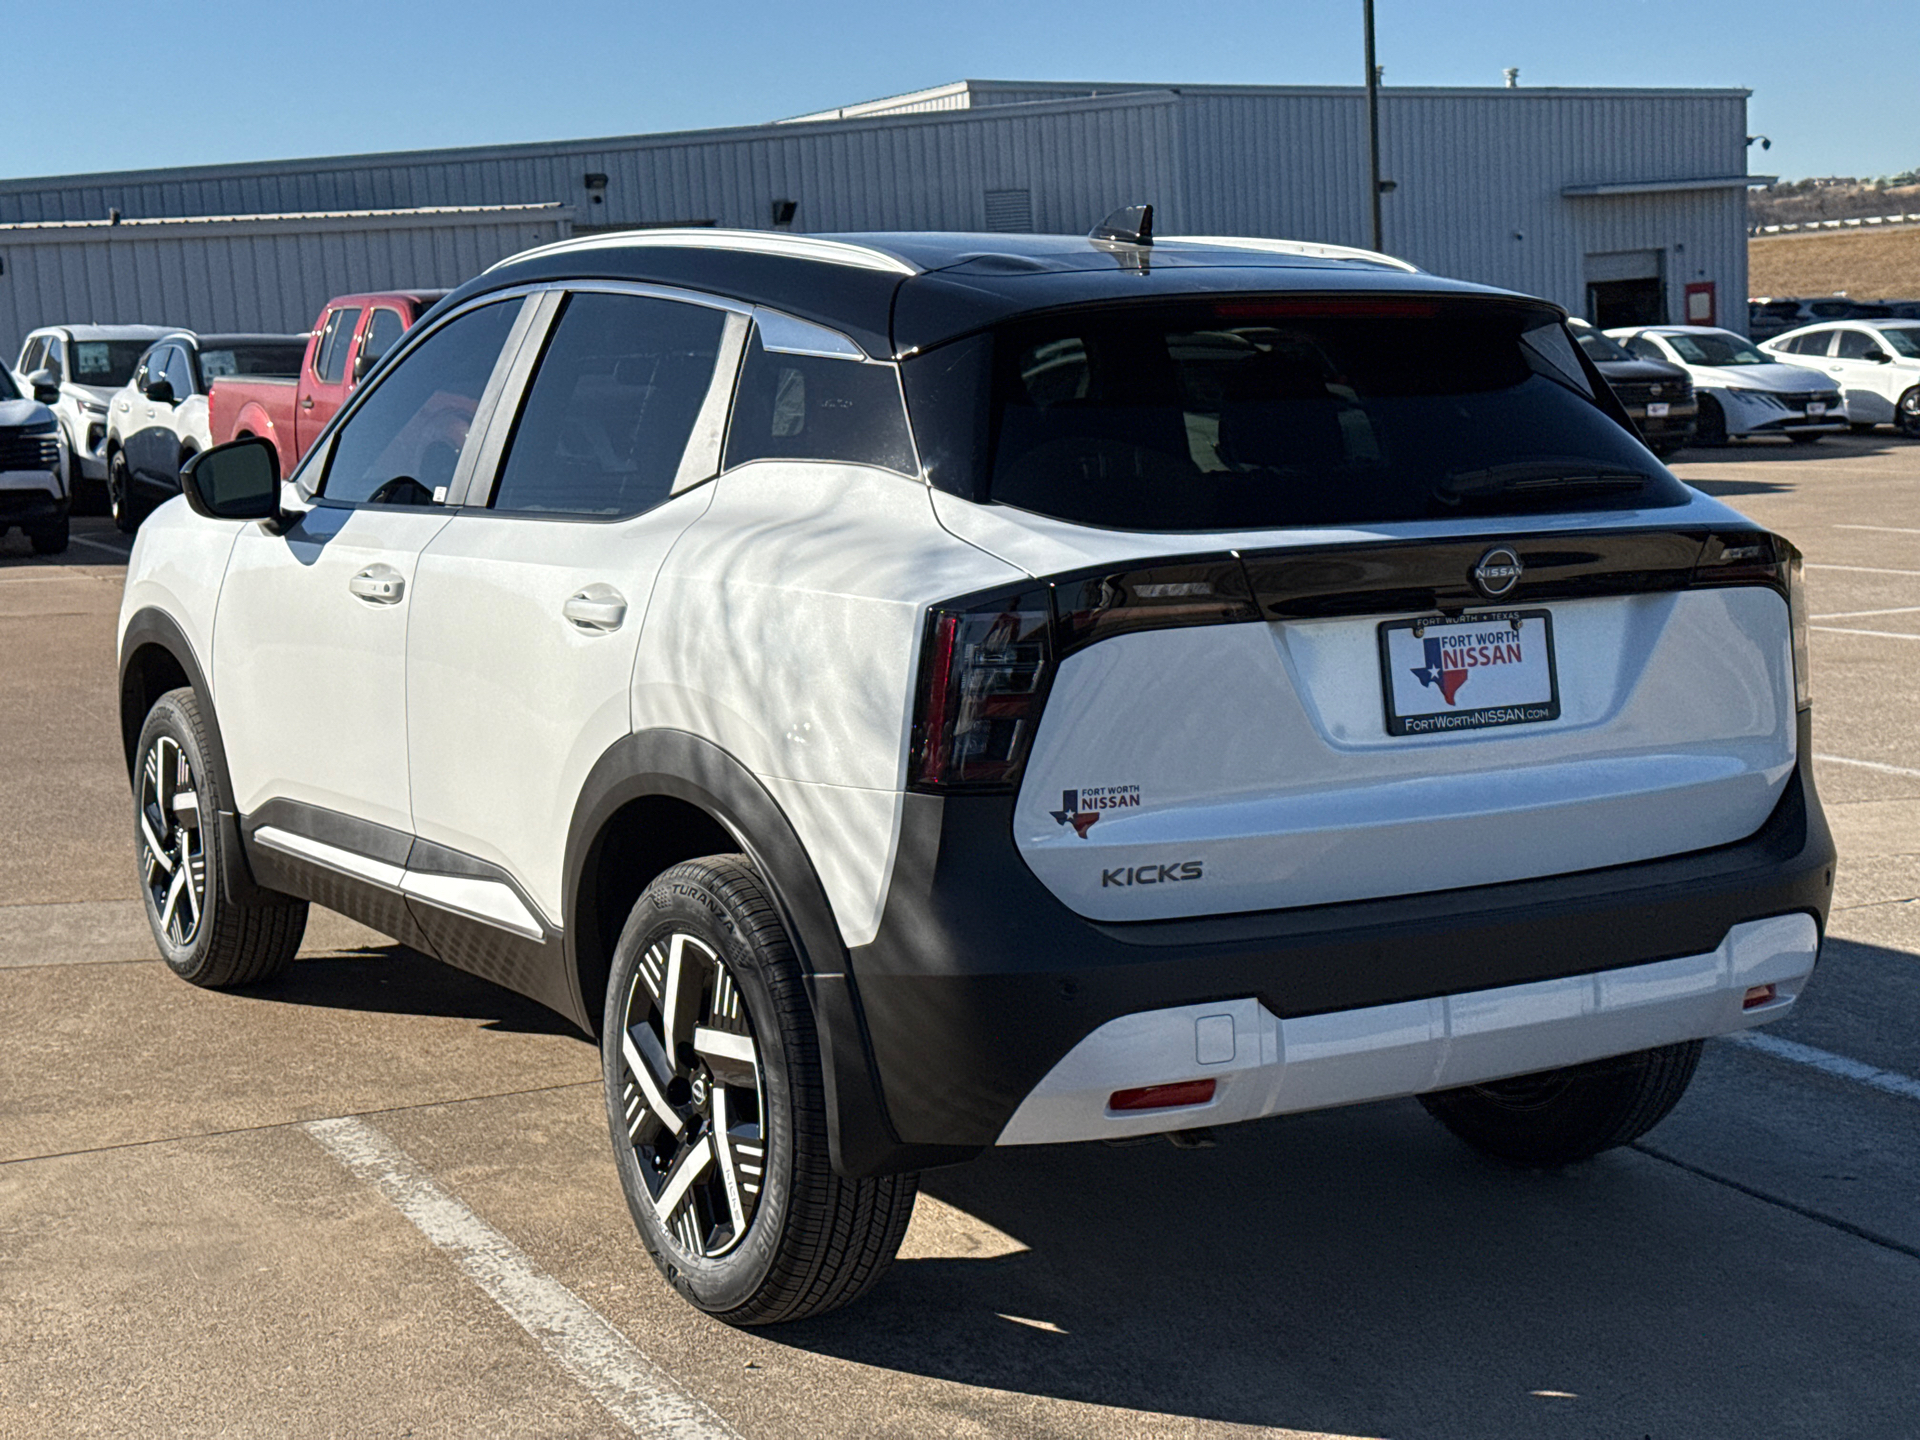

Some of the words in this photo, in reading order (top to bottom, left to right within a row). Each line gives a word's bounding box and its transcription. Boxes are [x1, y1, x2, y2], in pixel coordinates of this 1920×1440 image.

[1475, 566, 1523, 578] NISSAN
[1417, 618, 1440, 626] FORT
[1445, 614, 1478, 624] WORTH
[1492, 611, 1520, 620] TEXAS
[1442, 634, 1473, 648] FORT
[1476, 631, 1520, 646] WORTH
[1443, 644, 1522, 669] NISSAN
[1082, 787, 1106, 796] FORT
[1108, 785, 1140, 794] WORTH
[1082, 795, 1140, 810] NISSAN
[1102, 860, 1203, 888] KICKS
[671, 883, 736, 935] TURANZA
